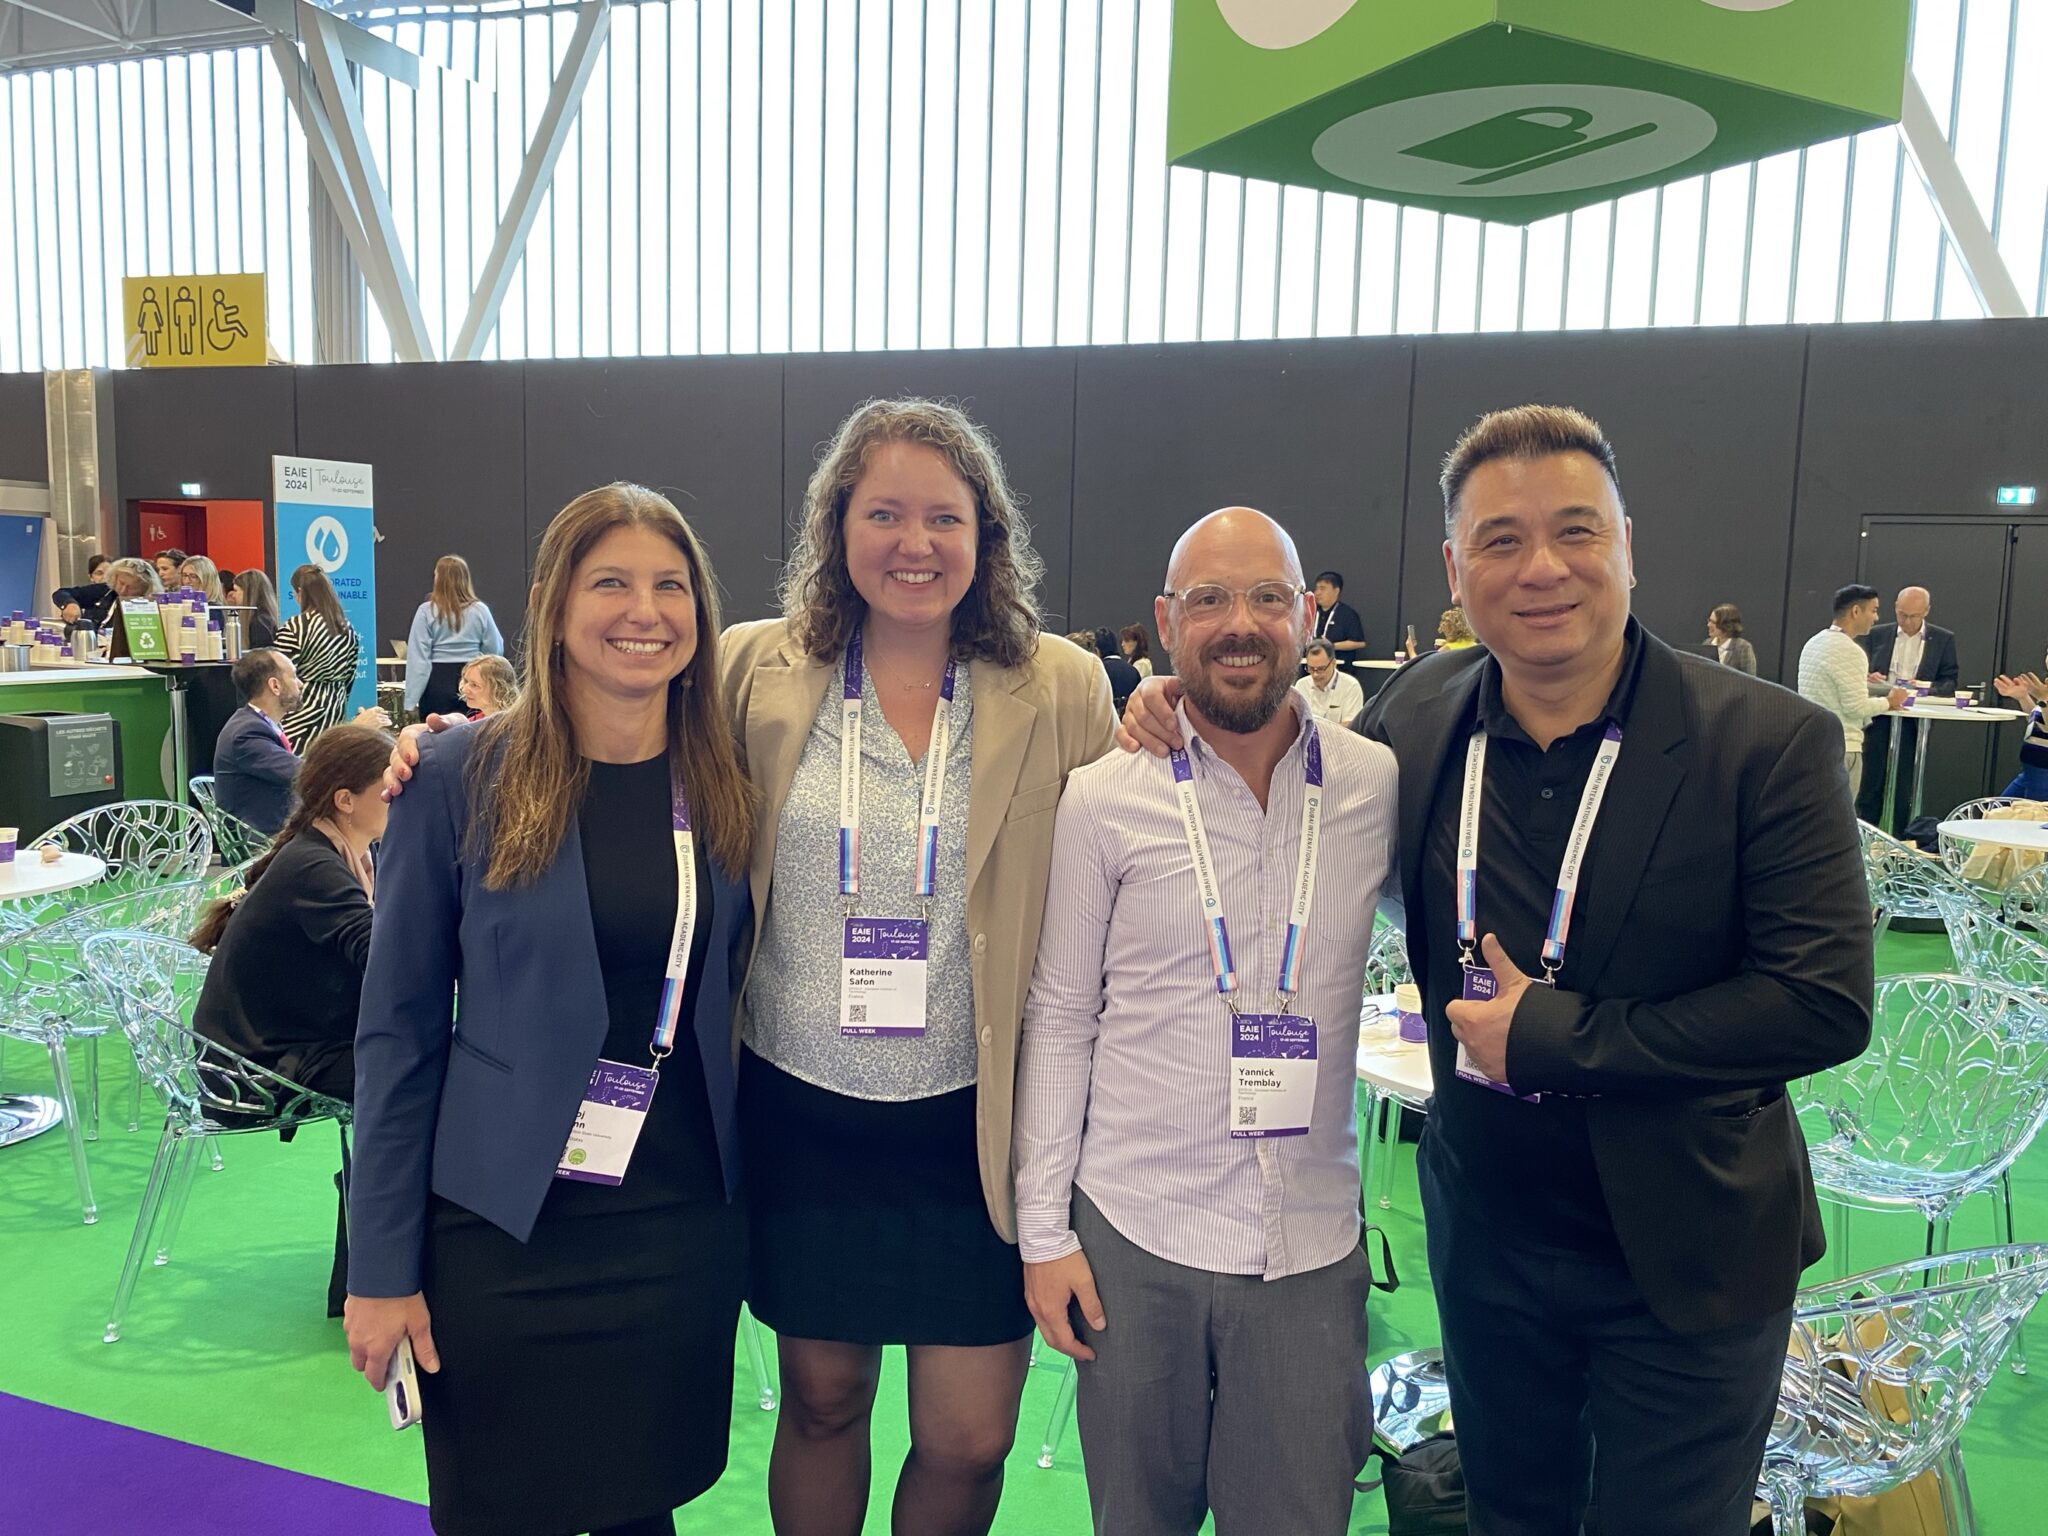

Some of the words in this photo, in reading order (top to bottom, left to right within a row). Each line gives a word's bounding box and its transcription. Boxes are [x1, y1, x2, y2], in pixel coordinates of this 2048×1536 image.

[284, 466, 307, 477] EAIE
[315, 469, 364, 488] Toulouse
[285, 480, 307, 489] 2024
[1579, 784, 1599, 831] INTERNATIONAL
[1193, 833, 1208, 878] INTERNATIONAL
[878, 928, 920, 940] Toulouse
[849, 968, 893, 976] Katherine
[1472, 975, 1493, 988] EAIE
[1472, 984, 1492, 995] 2024
[1240, 1025, 1259, 1033] EAIE
[1266, 1026, 1310, 1039] Toulouse
[1239, 1068, 1275, 1076] Yannick
[604, 1072, 647, 1090] Toulouse
[1239, 1078, 1281, 1088] Tremblay
